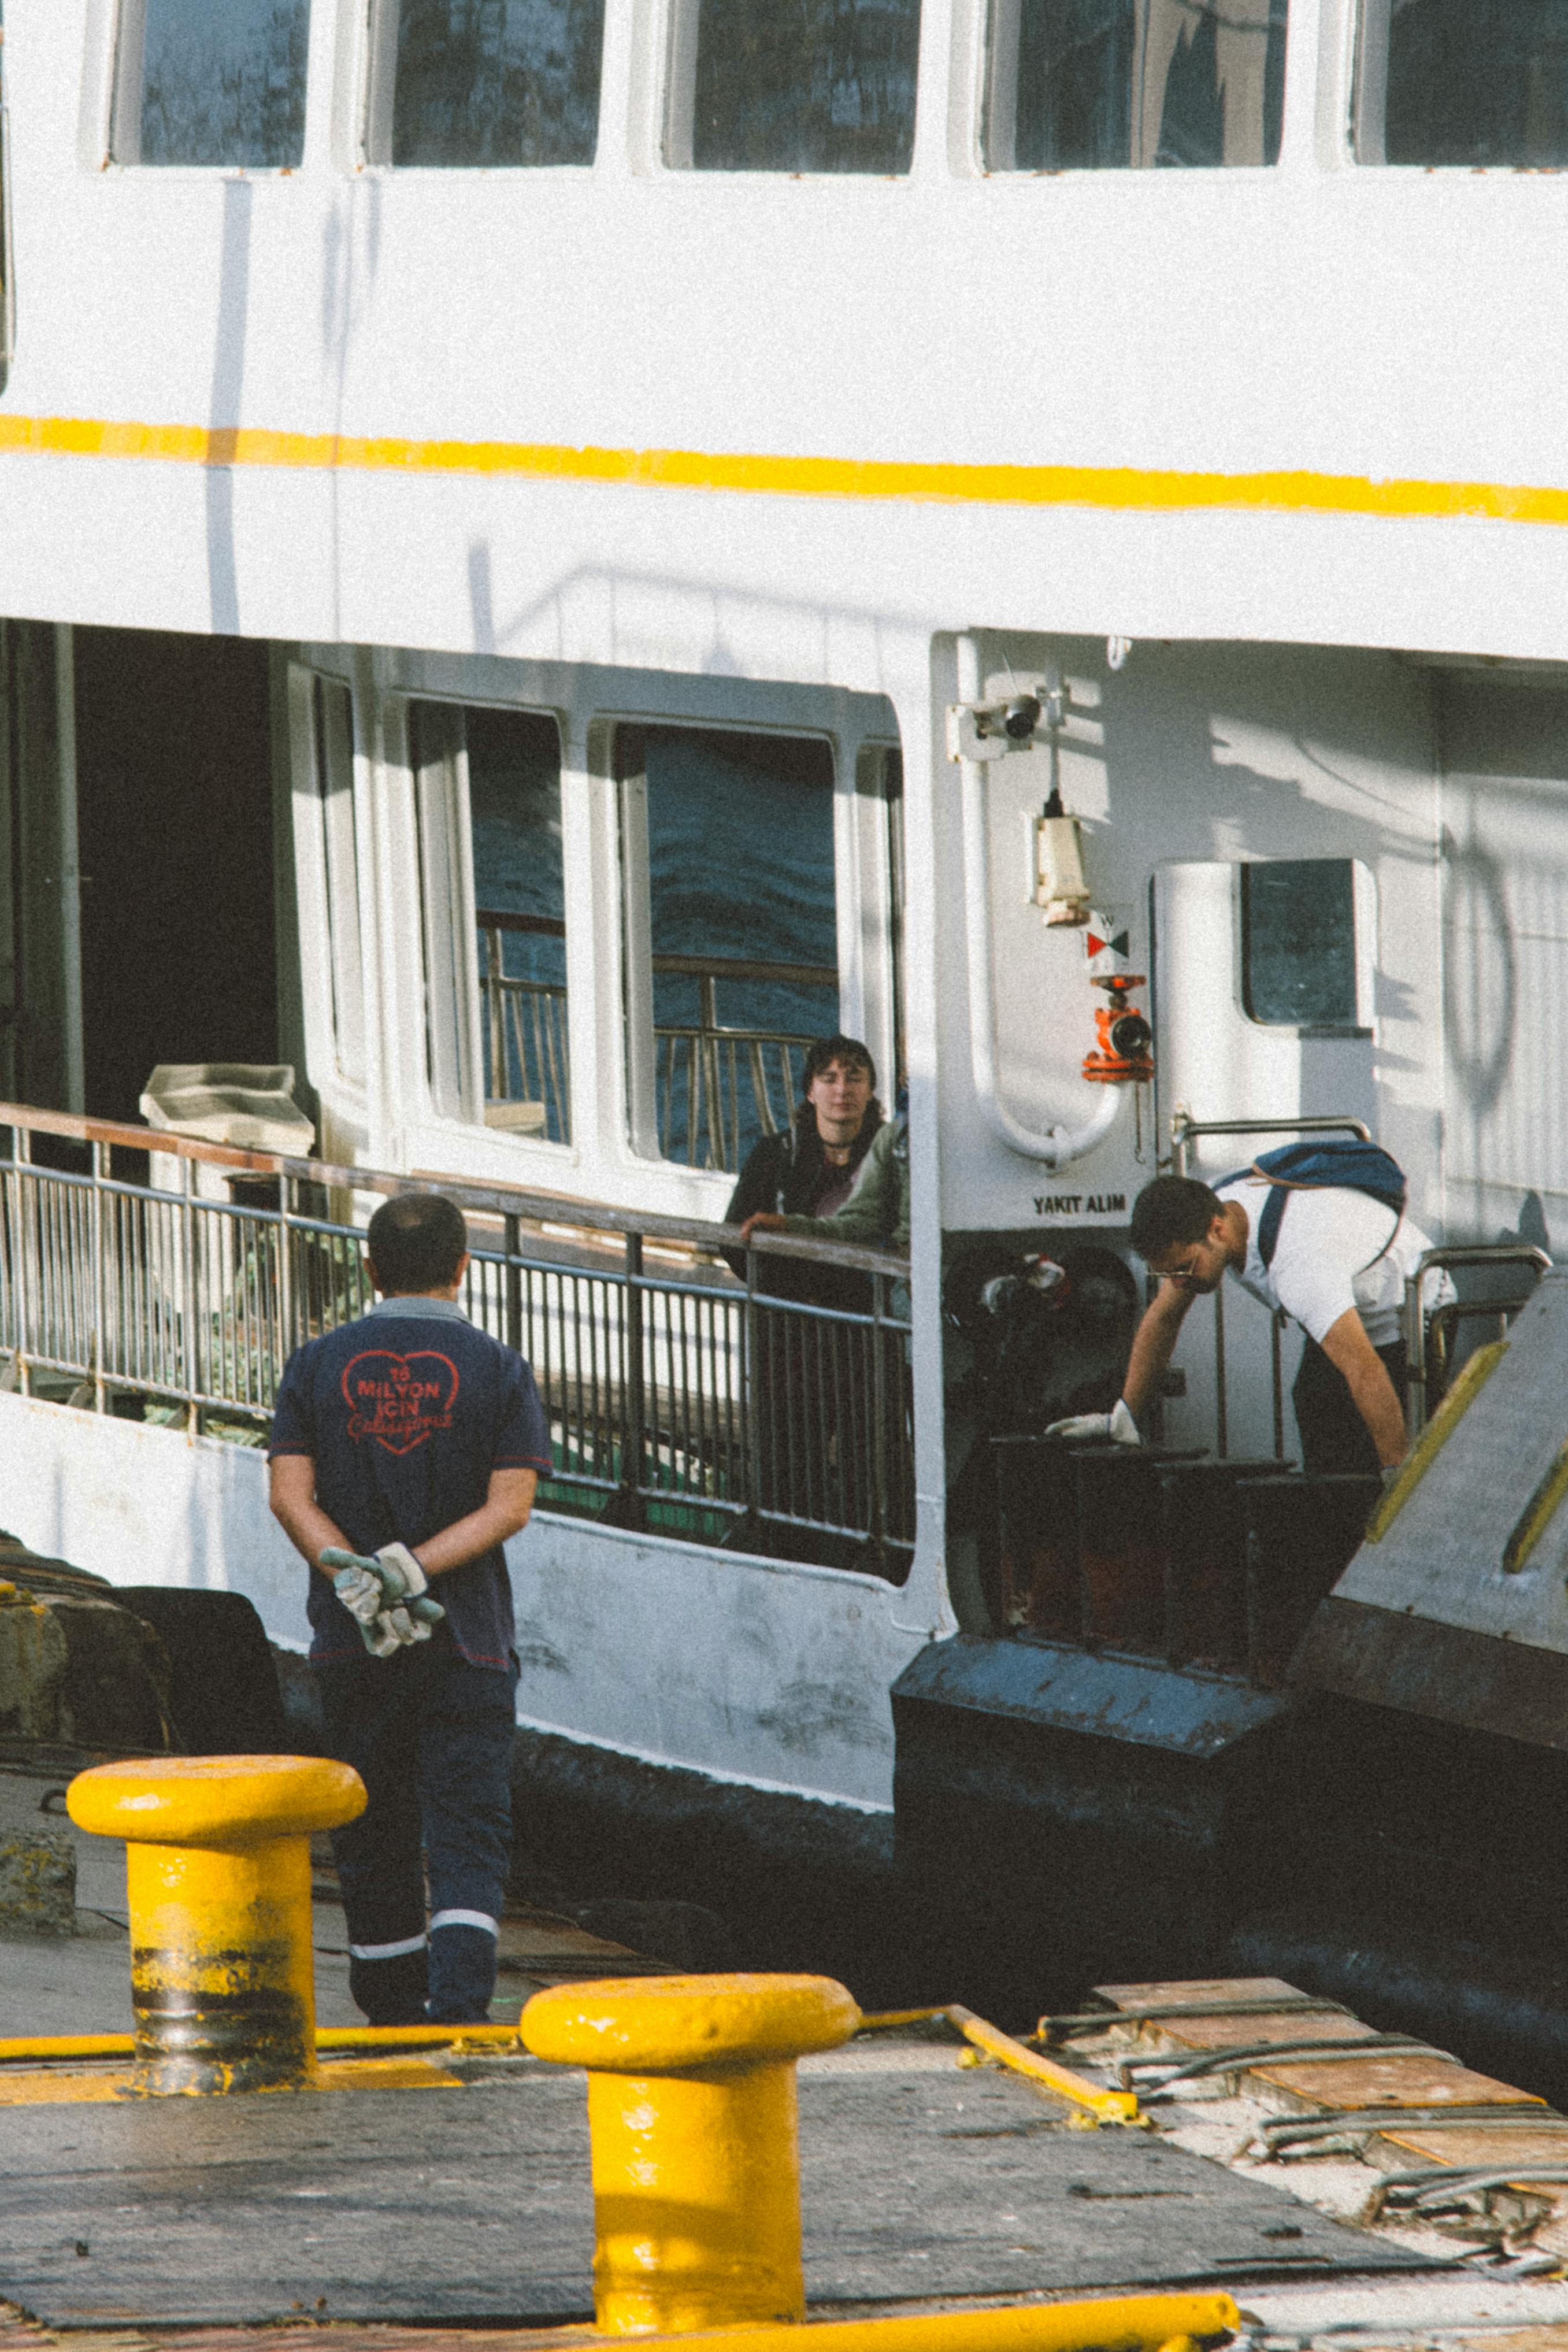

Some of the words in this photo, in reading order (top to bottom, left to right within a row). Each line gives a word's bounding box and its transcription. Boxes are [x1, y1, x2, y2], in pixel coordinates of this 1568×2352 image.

[1033, 1195, 1082, 1215] YAKIT
[1086, 1194, 1125, 1213] ALIM
[390, 1366, 410, 1382] 16
